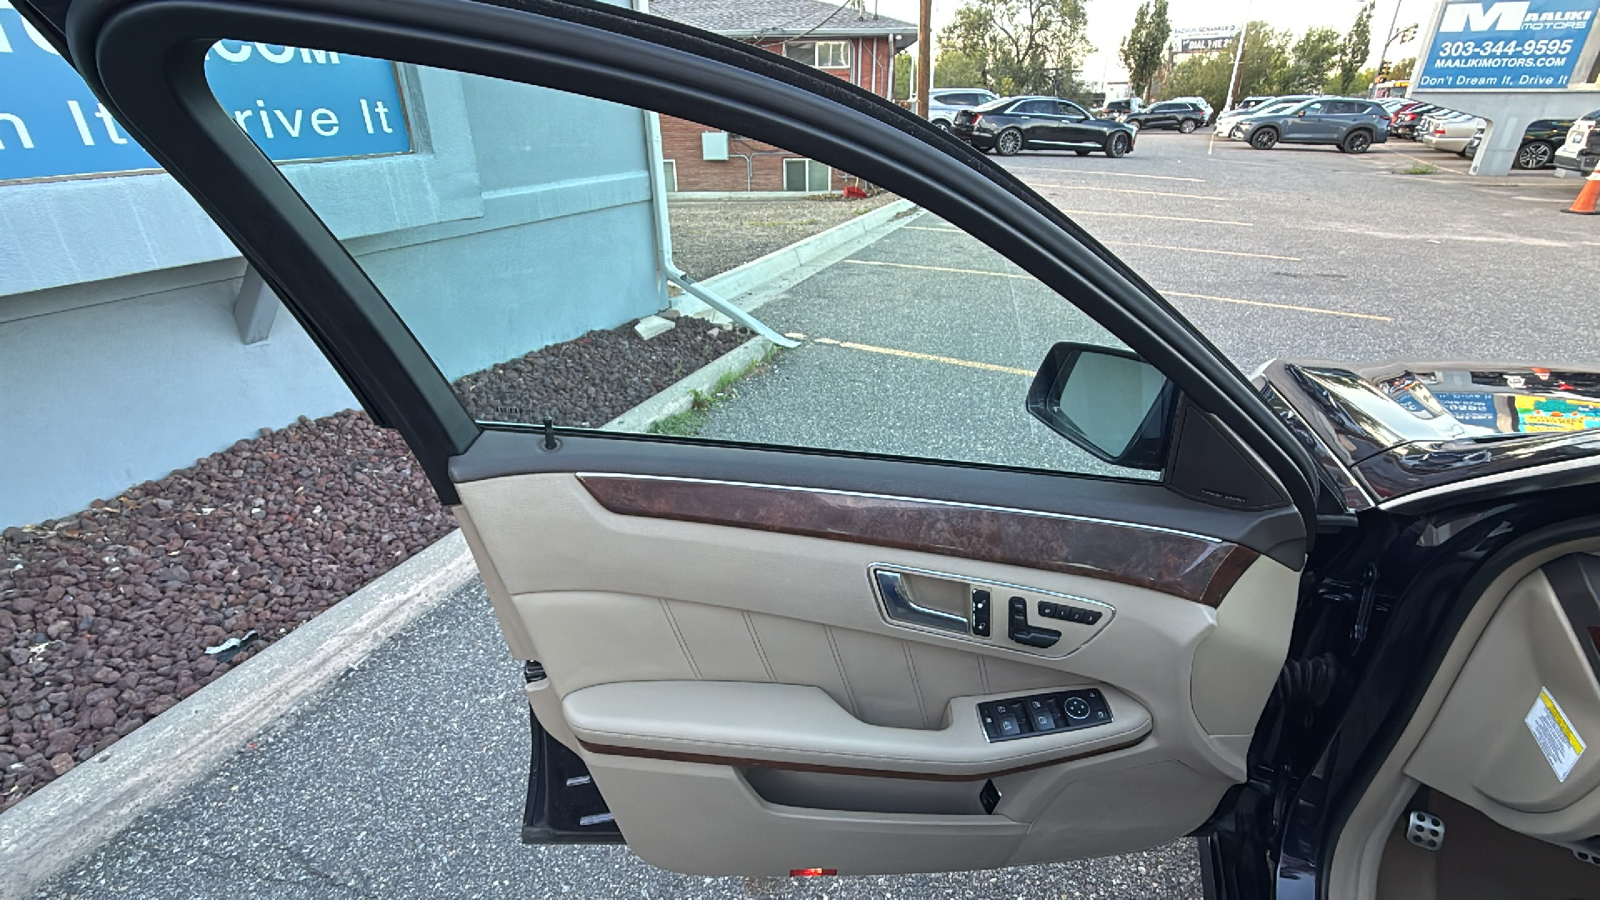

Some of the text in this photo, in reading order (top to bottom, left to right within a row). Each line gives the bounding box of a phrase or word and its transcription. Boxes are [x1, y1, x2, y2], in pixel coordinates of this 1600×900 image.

[1439, 1, 1592, 32] MAALIKI
[1521, 21, 1587, 30] MOTORS
[1439, 39, 1573, 57] 303-344-9595
[1434, 57, 1567, 68] MAALIKIMOTORS.COM
[1420, 76, 1452, 85] Don't
[1456, 75, 1497, 85] Dream
[1519, 74, 1554, 85] Drive
[1558, 74, 1568, 84] It
[234, 99, 339, 138] rive
[359, 99, 393, 134] It
